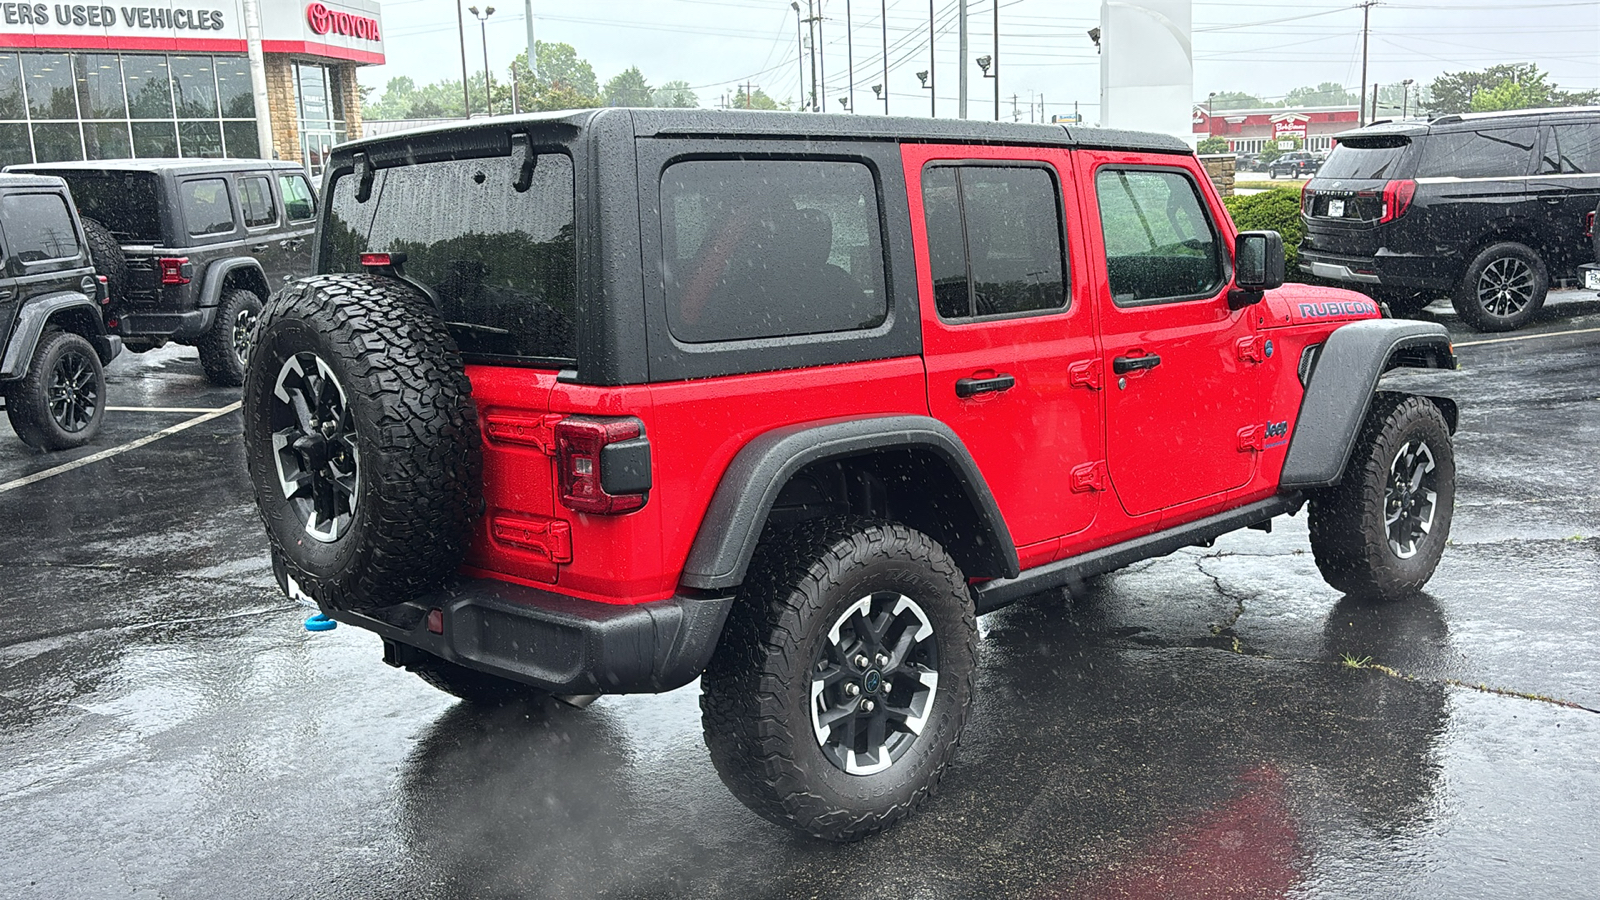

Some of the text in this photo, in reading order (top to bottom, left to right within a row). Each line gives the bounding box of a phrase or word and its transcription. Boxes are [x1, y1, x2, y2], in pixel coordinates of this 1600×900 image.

[0, 3, 224, 30] ERS USED VEHICLES
[328, 10, 380, 41] TOYOTA
[1299, 302, 1375, 318] RUBICON
[1264, 420, 1288, 439] Jeep
